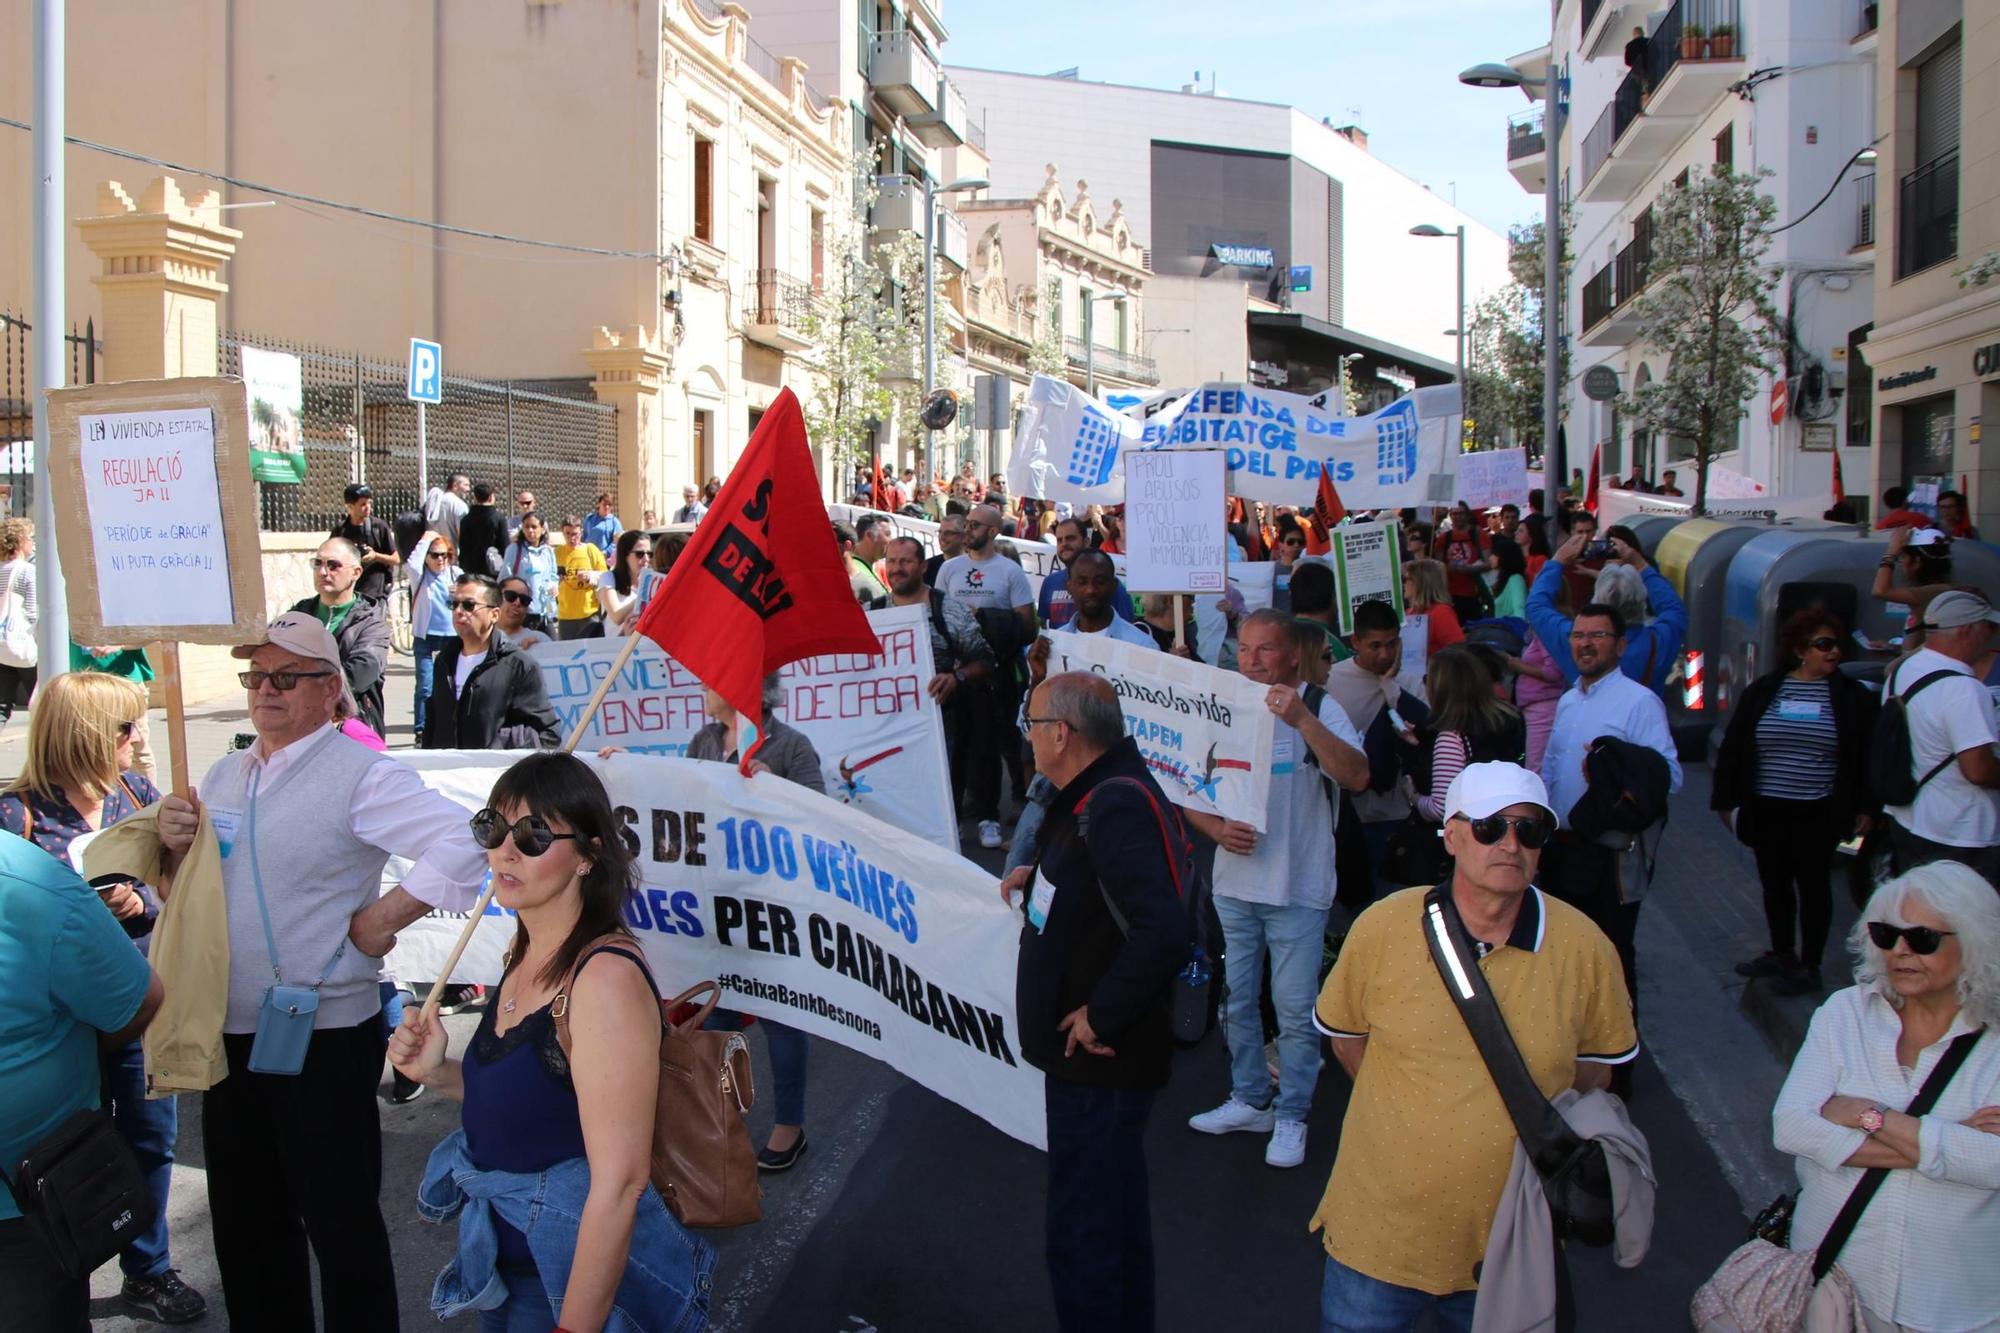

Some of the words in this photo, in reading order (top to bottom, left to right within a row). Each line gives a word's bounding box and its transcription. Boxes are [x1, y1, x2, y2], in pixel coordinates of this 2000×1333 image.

[1221, 247, 1273, 265] PARKING
[415, 346, 435, 393] P
[90, 419, 105, 441] LEY
[111, 418, 164, 440] VIVIENDA
[169, 419, 210, 435] ESTATAL
[1306, 415, 1345, 438] DE
[102, 450, 183, 486] REGULACIÓ
[1134, 454, 1173, 478] PROU
[1227, 447, 1276, 479] DEL
[1145, 479, 1201, 501] ABUSOS
[1135, 502, 1176, 525] PROU
[112, 552, 125, 571] NI
[128, 554, 156, 569] PUTA
[718, 542, 754, 583] DE
[795, 684, 834, 722] DE
[839, 675, 921, 719] CASA
[1111, 673, 1158, 705] aixa
[1188, 693, 1232, 728] vida
[651, 808, 707, 866] DE
[716, 816, 799, 882] 100
[802, 833, 919, 945] VEÏNES
[713, 896, 801, 958] PER
[808, 912, 1018, 1069] CAIXABANK
[717, 973, 882, 1041] #CaixaBankDesnona
